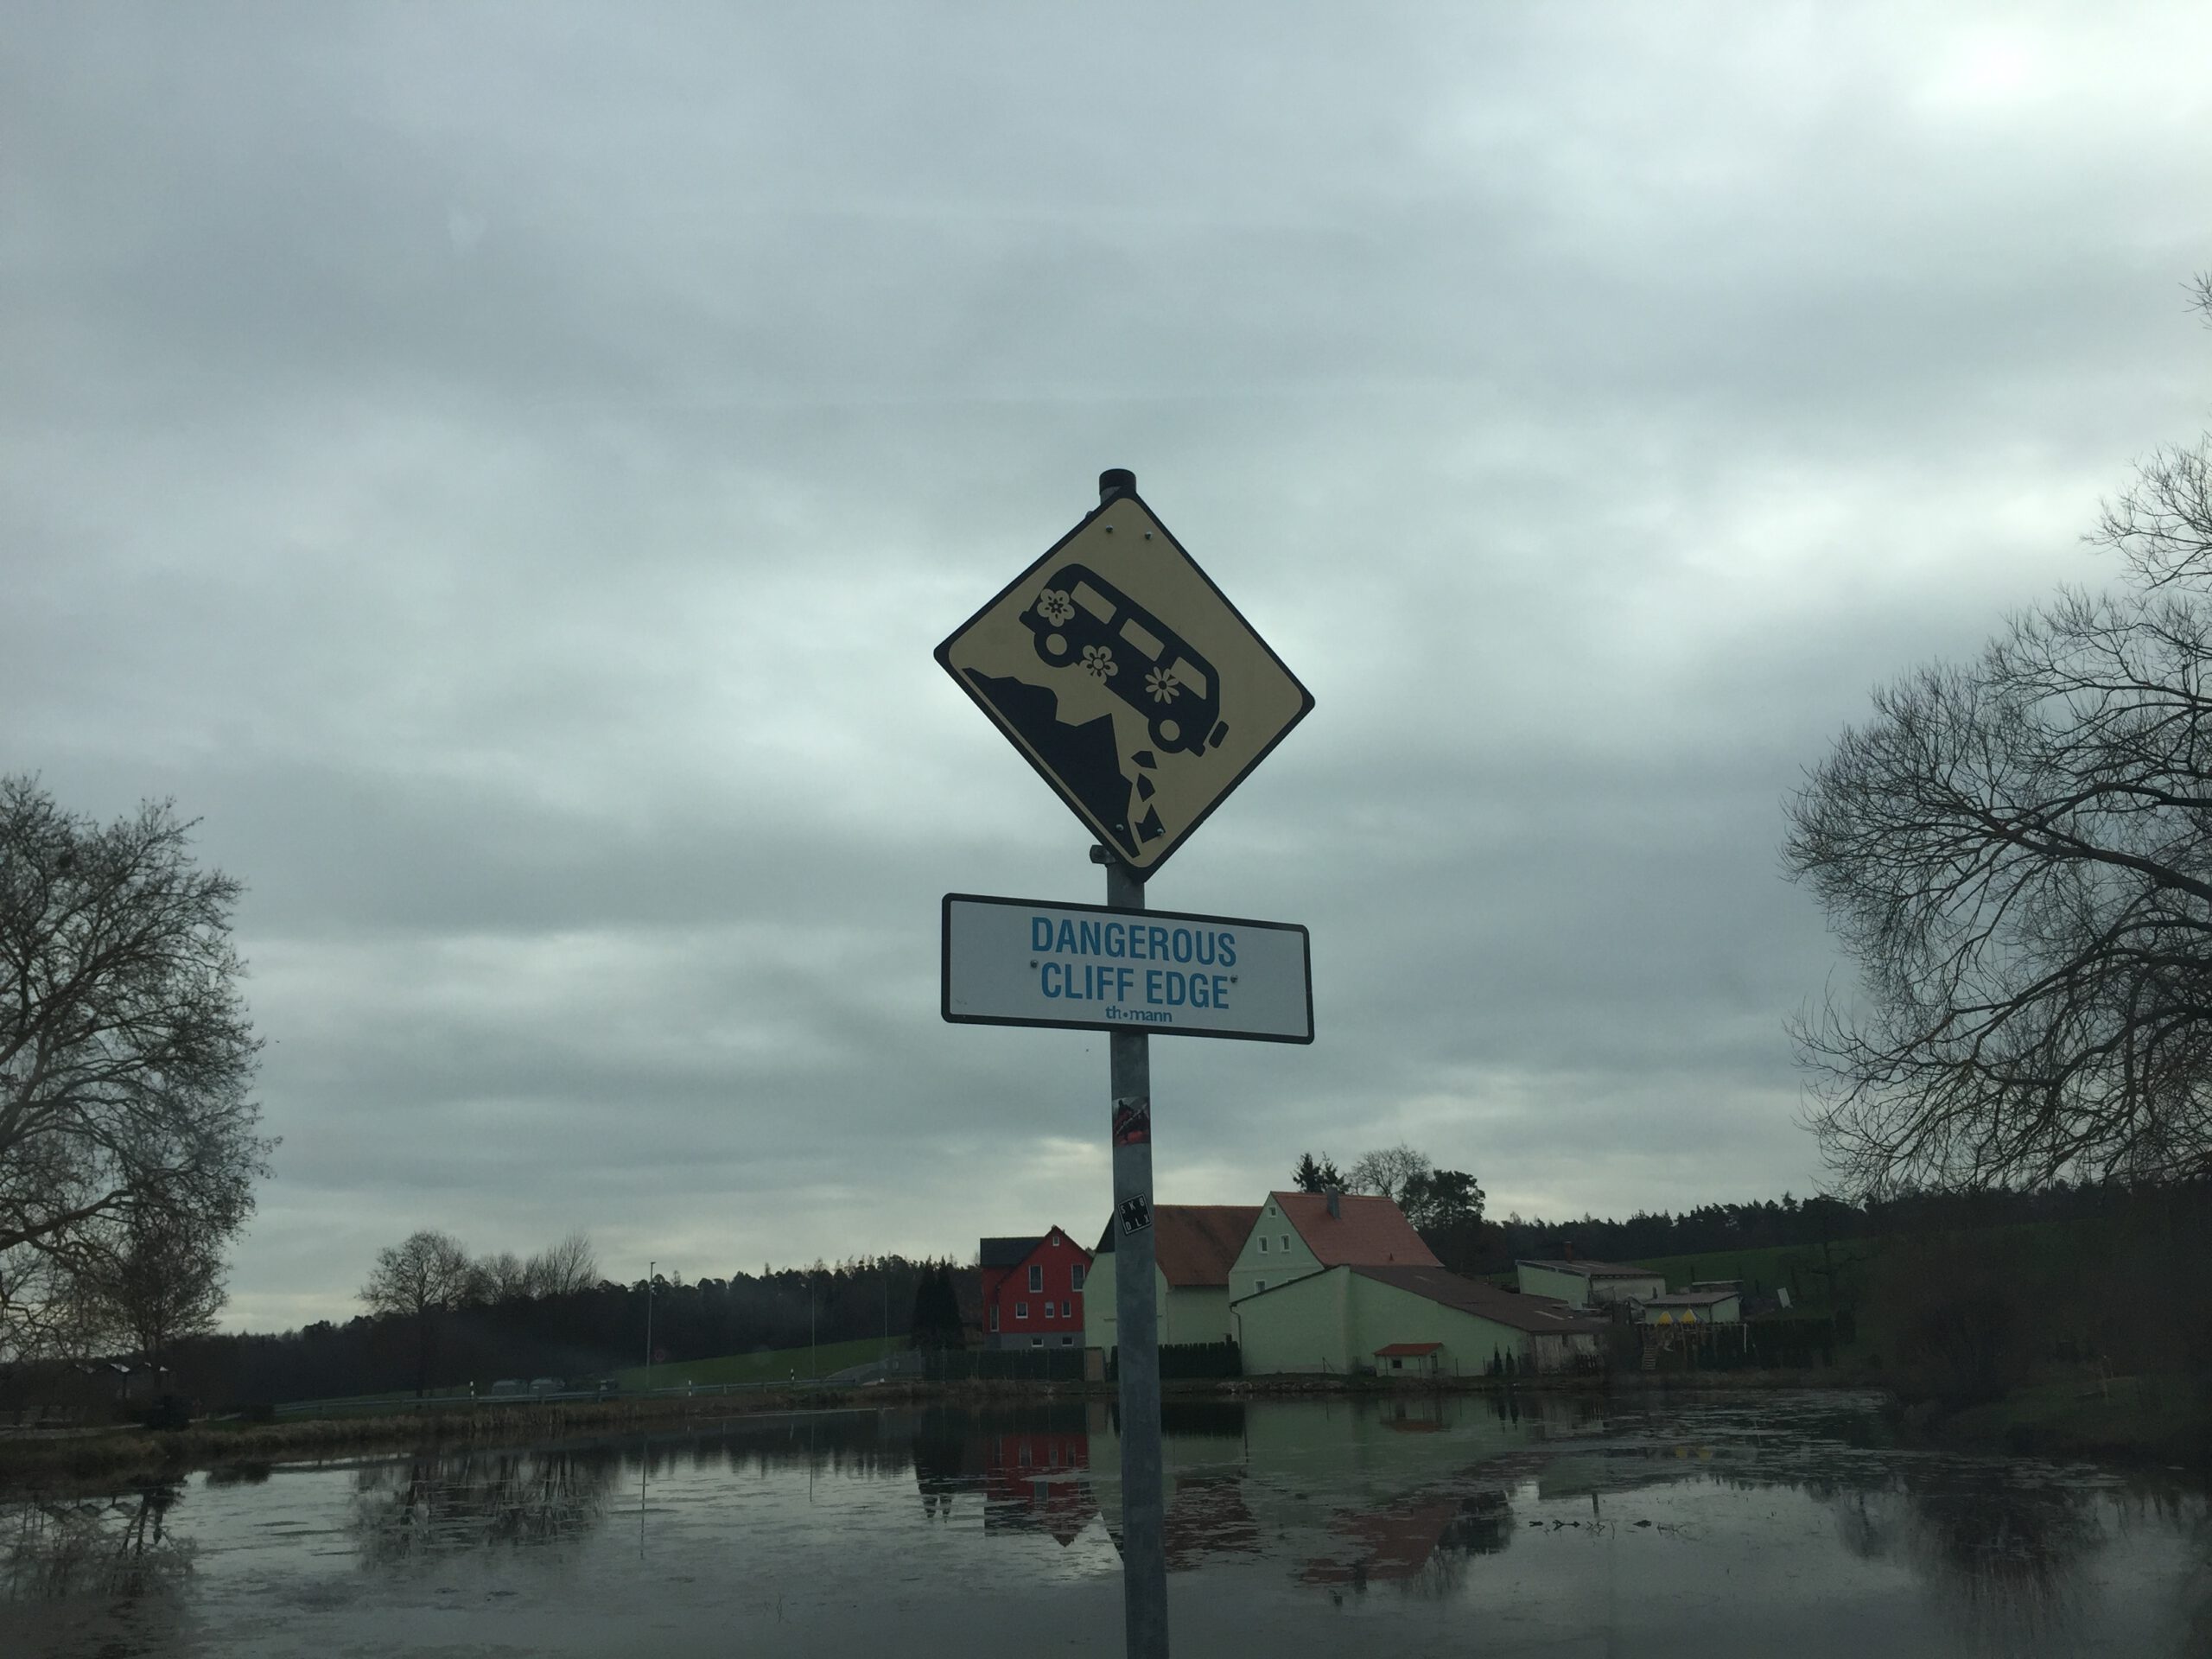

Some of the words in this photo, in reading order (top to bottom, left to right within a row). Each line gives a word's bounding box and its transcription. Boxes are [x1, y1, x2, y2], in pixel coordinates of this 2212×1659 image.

[1032, 917, 1236, 967] DANGEROUS
[1041, 963, 1134, 1001] CLIFF
[1147, 970, 1230, 1009] EDGE
[1121, 1198, 1145, 1214] SK8
[1126, 1216, 1150, 1230] DLX
